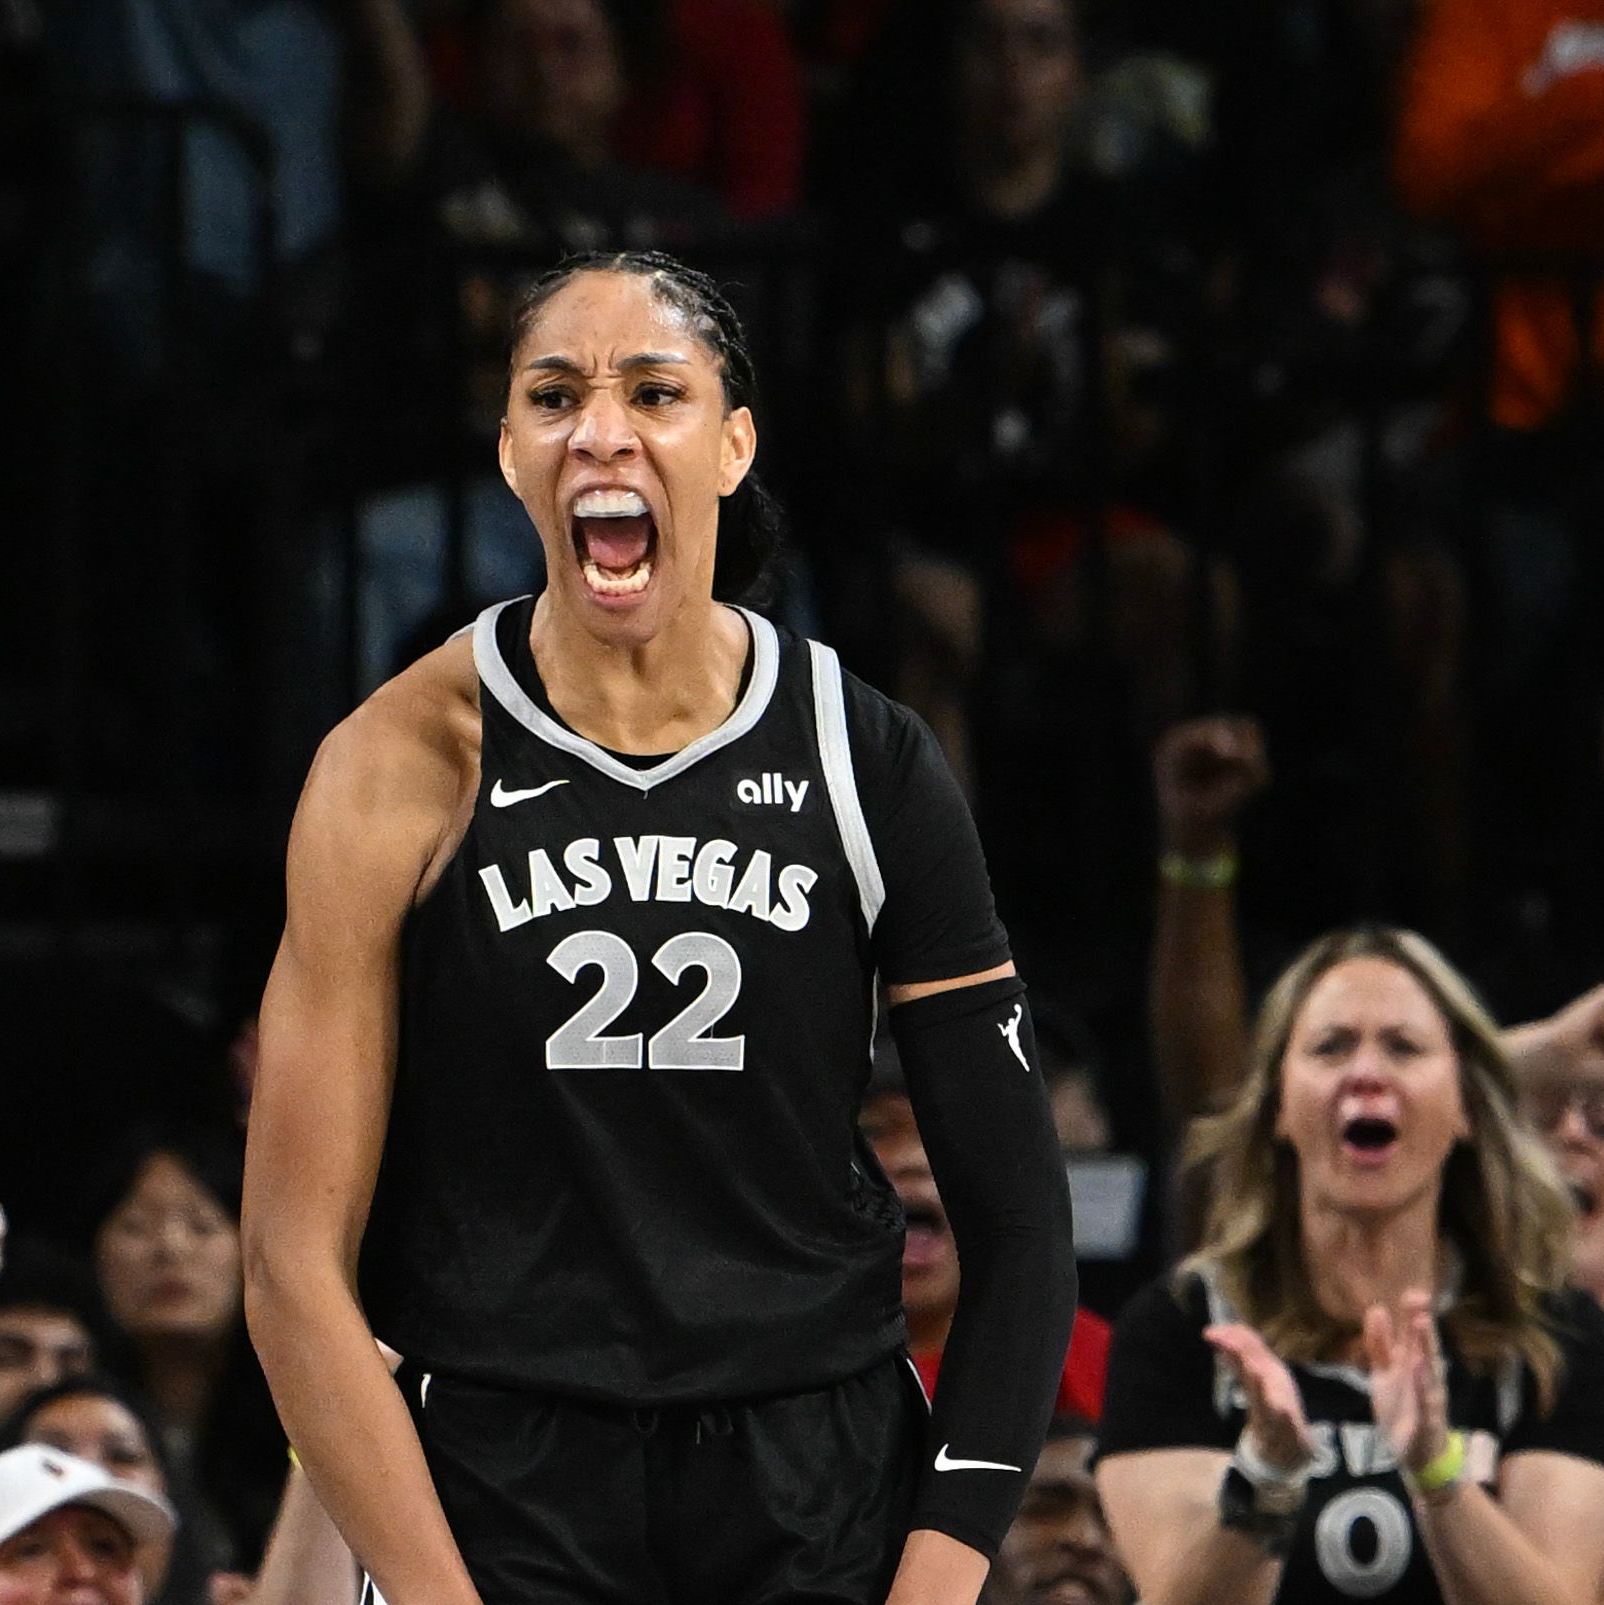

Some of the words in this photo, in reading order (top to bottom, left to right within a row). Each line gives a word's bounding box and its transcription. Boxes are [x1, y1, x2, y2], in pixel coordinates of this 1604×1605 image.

[736, 772, 810, 812] ally
[478, 838, 612, 932] LAS
[613, 835, 818, 932] VEGAS
[545, 929, 745, 1071] 22
[1314, 1485, 1413, 1600] 0
